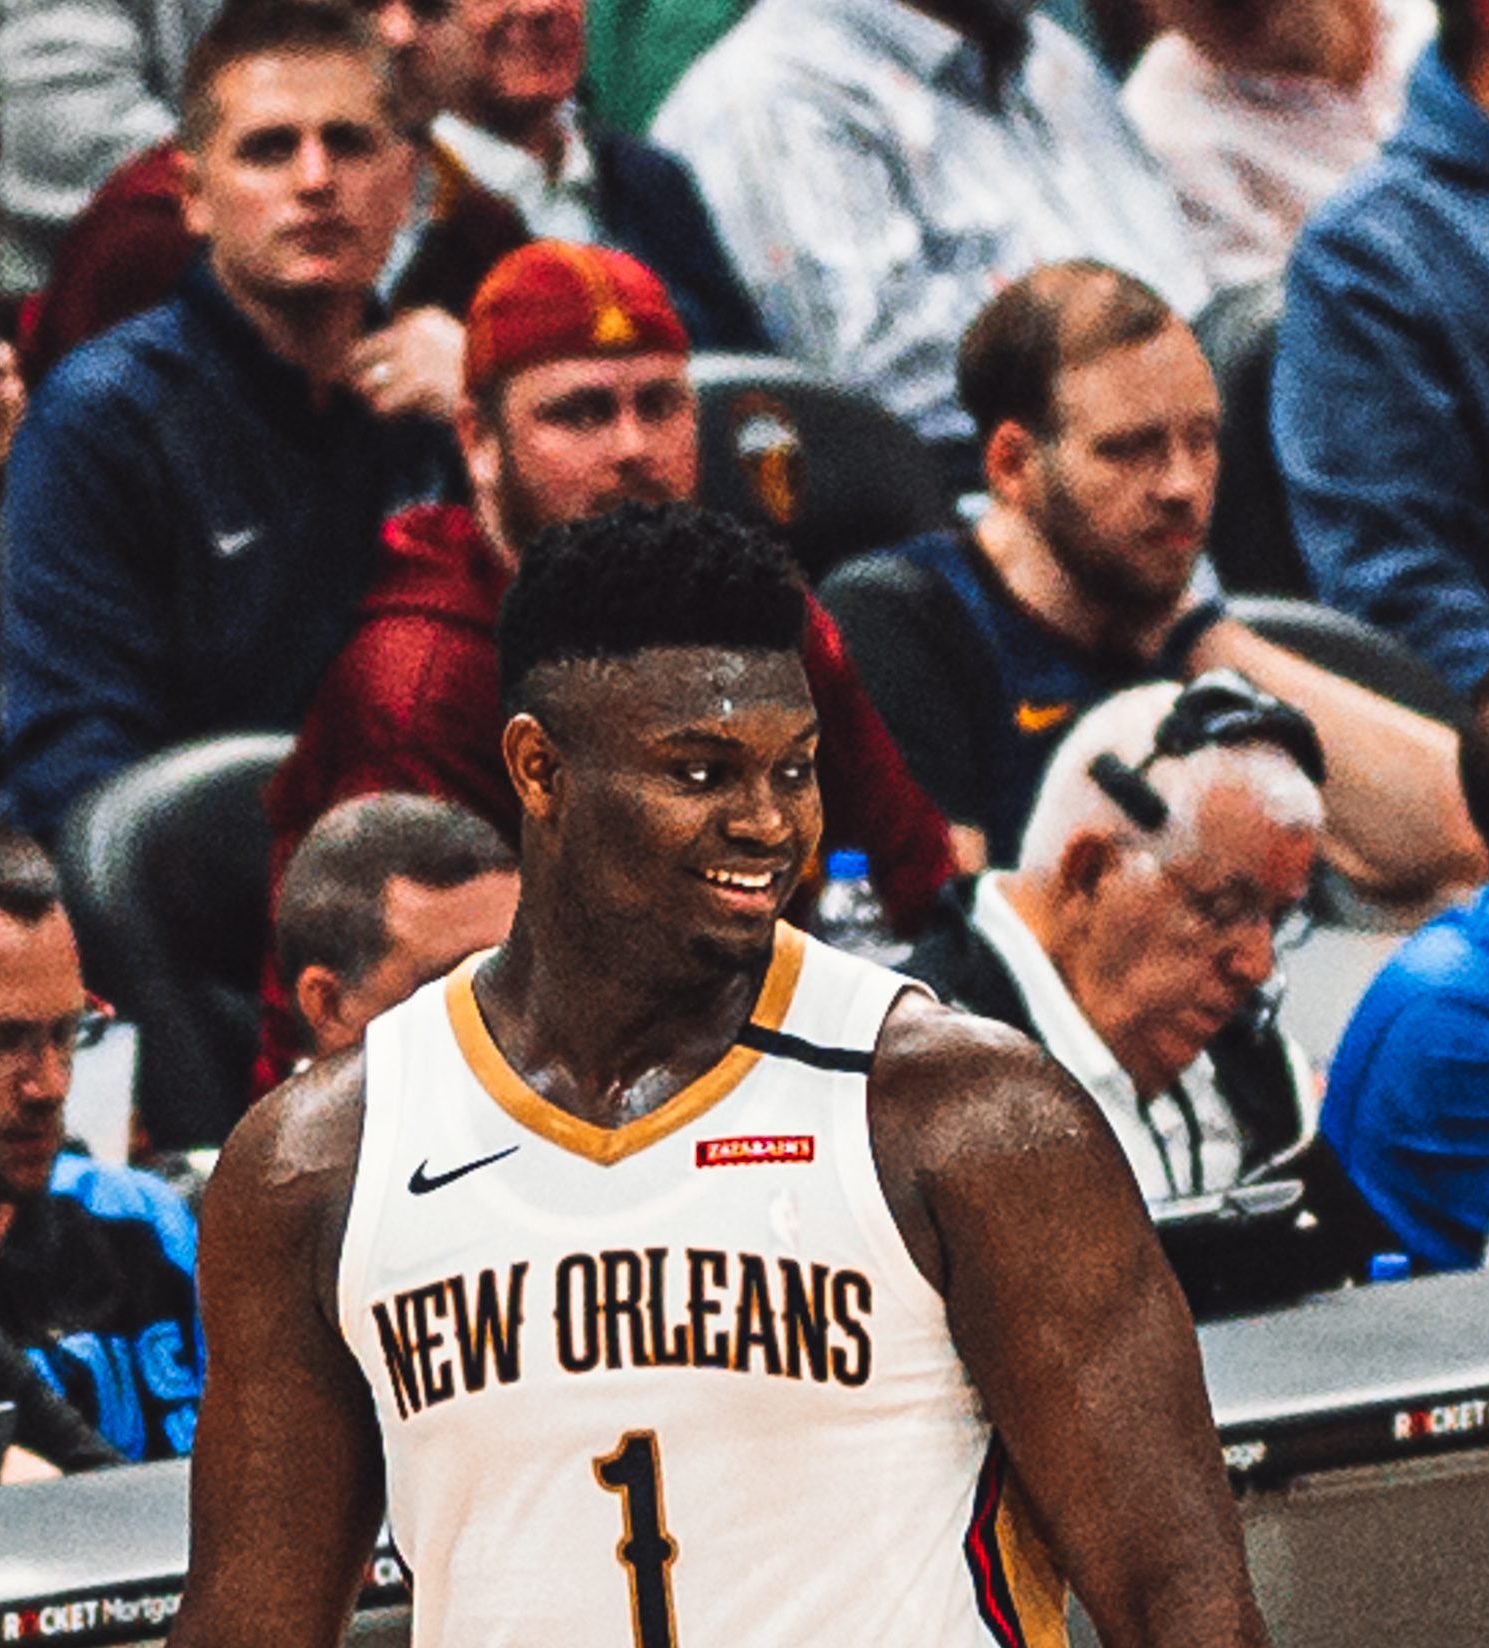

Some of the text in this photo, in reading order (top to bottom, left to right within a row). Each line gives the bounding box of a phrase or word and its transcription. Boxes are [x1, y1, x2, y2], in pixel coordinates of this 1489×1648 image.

[372, 1262, 530, 1422] NEW
[553, 1247, 873, 1388] ORLEANS
[1394, 1399, 1487, 1441] ROCKET
[2, 1592, 183, 1642] ROCKET Mortga
